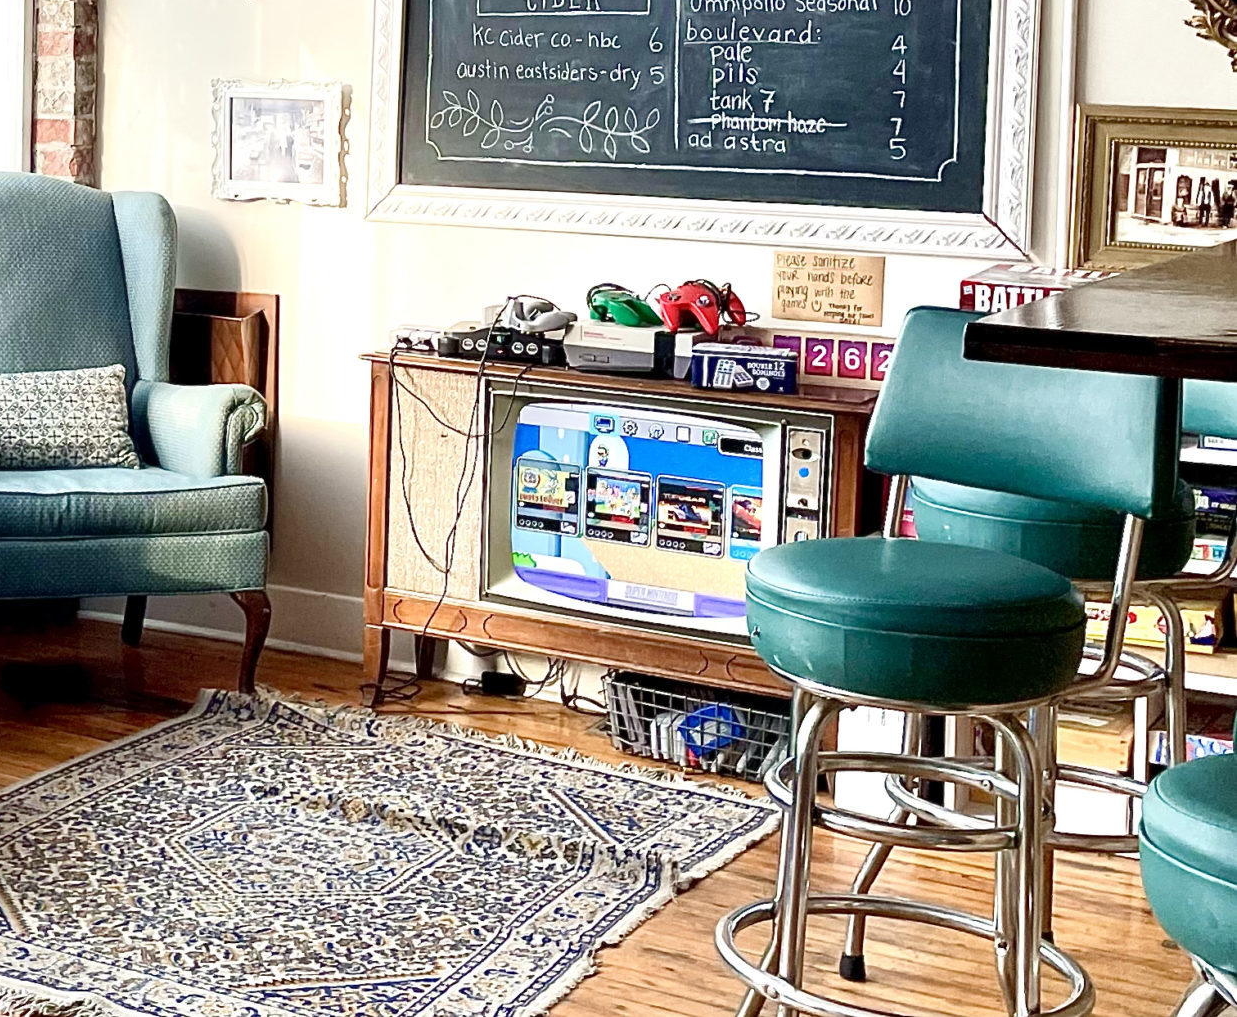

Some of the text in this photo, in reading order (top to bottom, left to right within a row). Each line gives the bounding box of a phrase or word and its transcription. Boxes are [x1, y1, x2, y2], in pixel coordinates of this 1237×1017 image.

[473, 23, 494, 46] KC
[649, 27, 663, 53] 6
[710, 35, 907, 65] pale 4
[457, 60, 509, 80] austin
[650, 67, 664, 84] 5
[712, 59, 906, 87] pils 4
[710, 88, 905, 113] tank 7 7
[890, 118, 902, 135] 7
[688, 131, 907, 160] ad astra 5
[974, 284, 1064, 313] BATT
